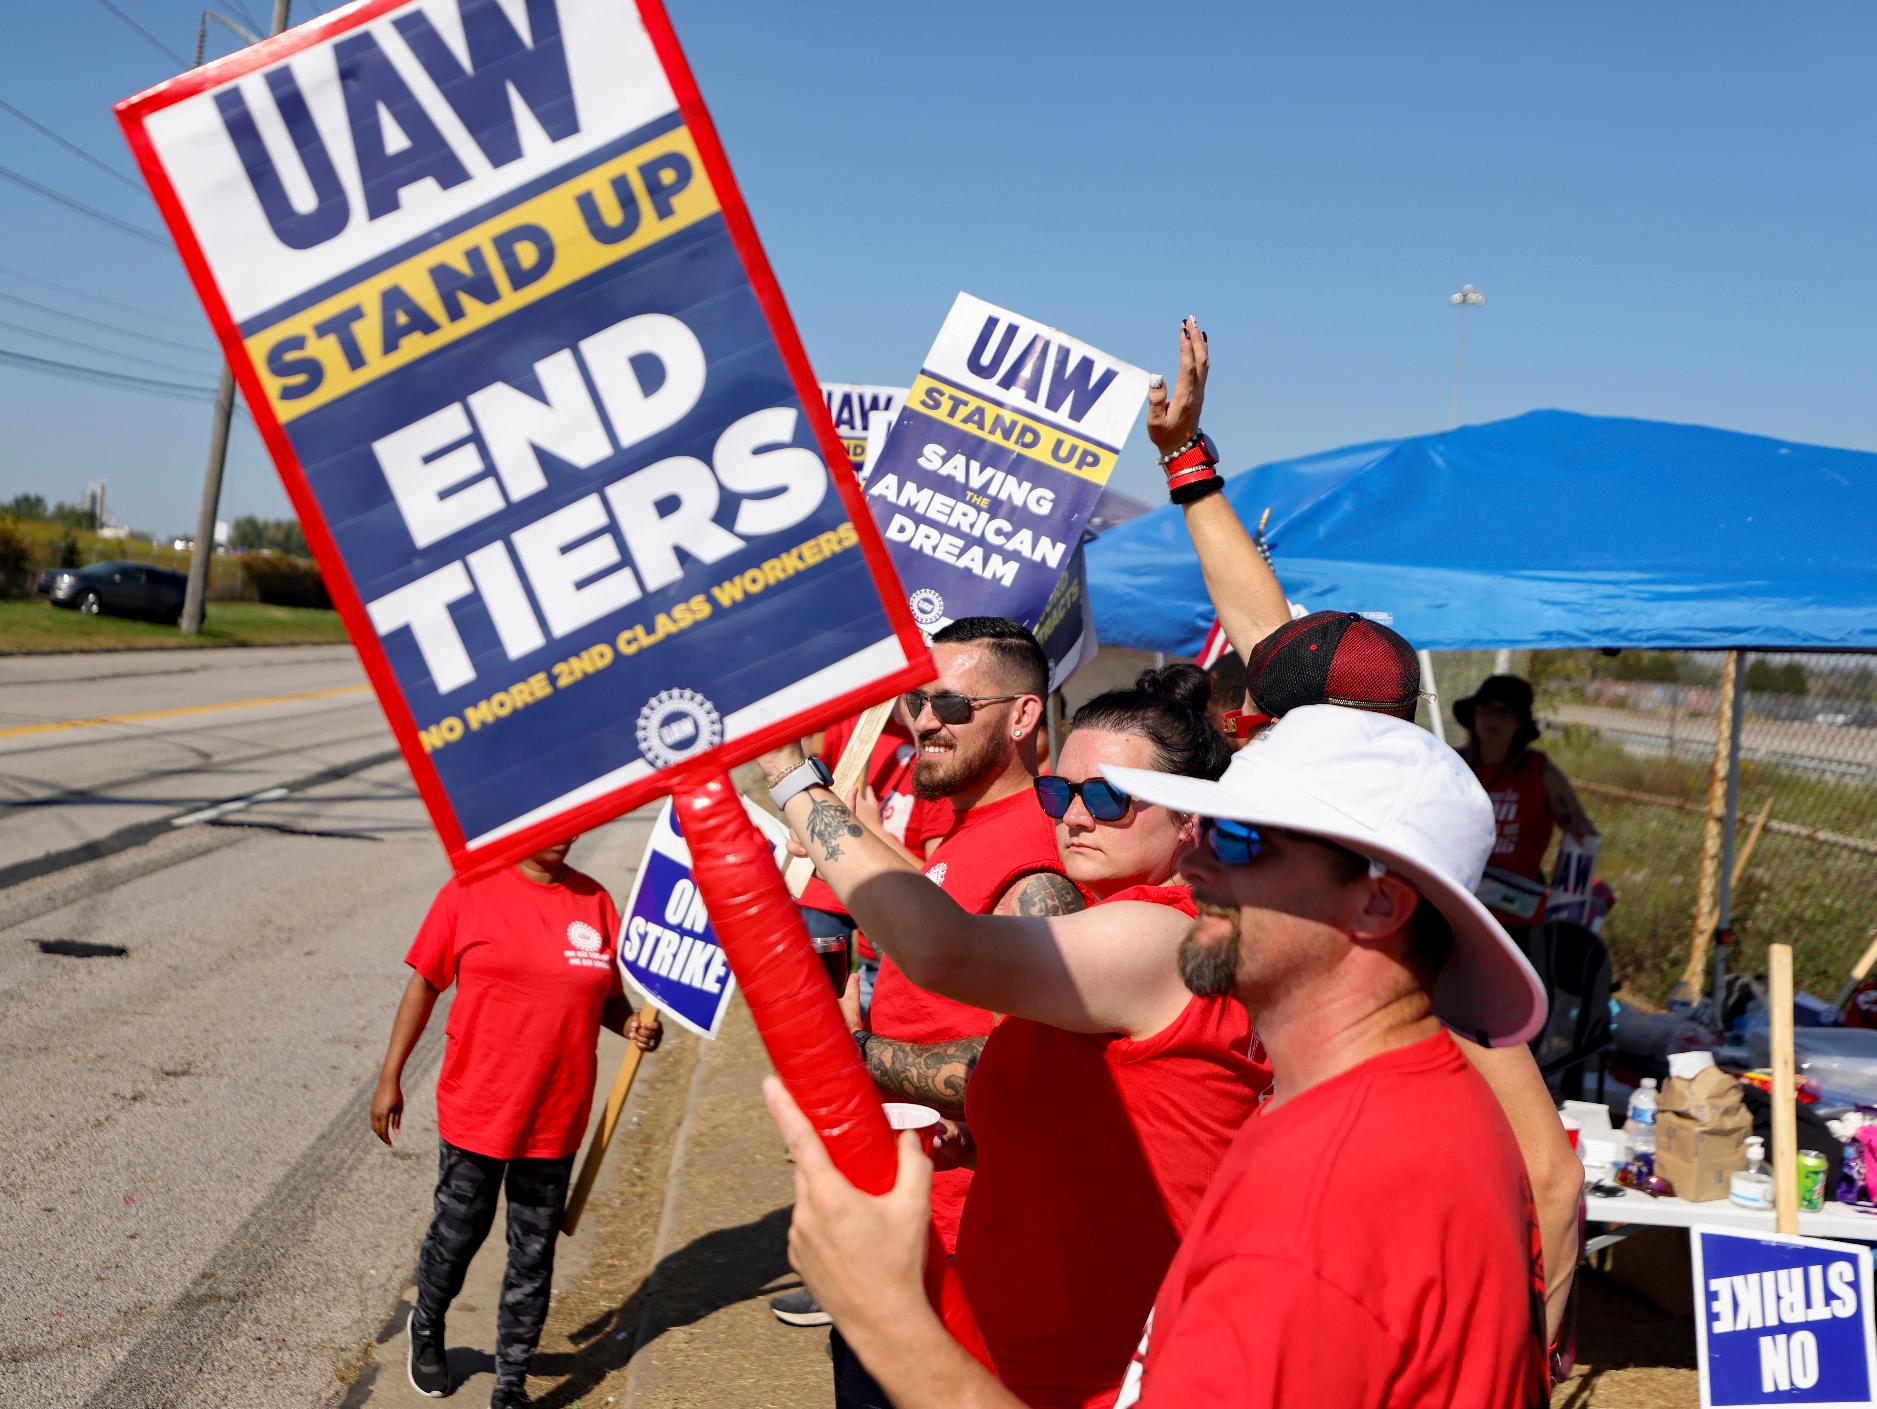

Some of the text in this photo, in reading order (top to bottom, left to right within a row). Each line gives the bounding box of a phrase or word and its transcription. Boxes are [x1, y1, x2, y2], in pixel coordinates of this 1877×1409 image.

[213, 0, 580, 251] UAW
[266, 151, 693, 401] STAND UP
[967, 314, 1119, 423] UAW
[372, 313, 707, 549] END
[918, 385, 1101, 471] STAND UP
[869, 473, 1067, 570] AMERICAN
[916, 443, 1056, 517] SAVING
[965, 491, 991, 508] THE
[367, 407, 828, 695] TIERS
[885, 513, 1021, 588] DREAM
[418, 522, 859, 754] NO MORE 2ND CLASS WORKERS
[664, 878, 709, 934] ON
[623, 915, 727, 994] STRIKE
[1709, 1260, 1858, 1334] STRIKE
[1759, 1330, 1820, 1393] ON
